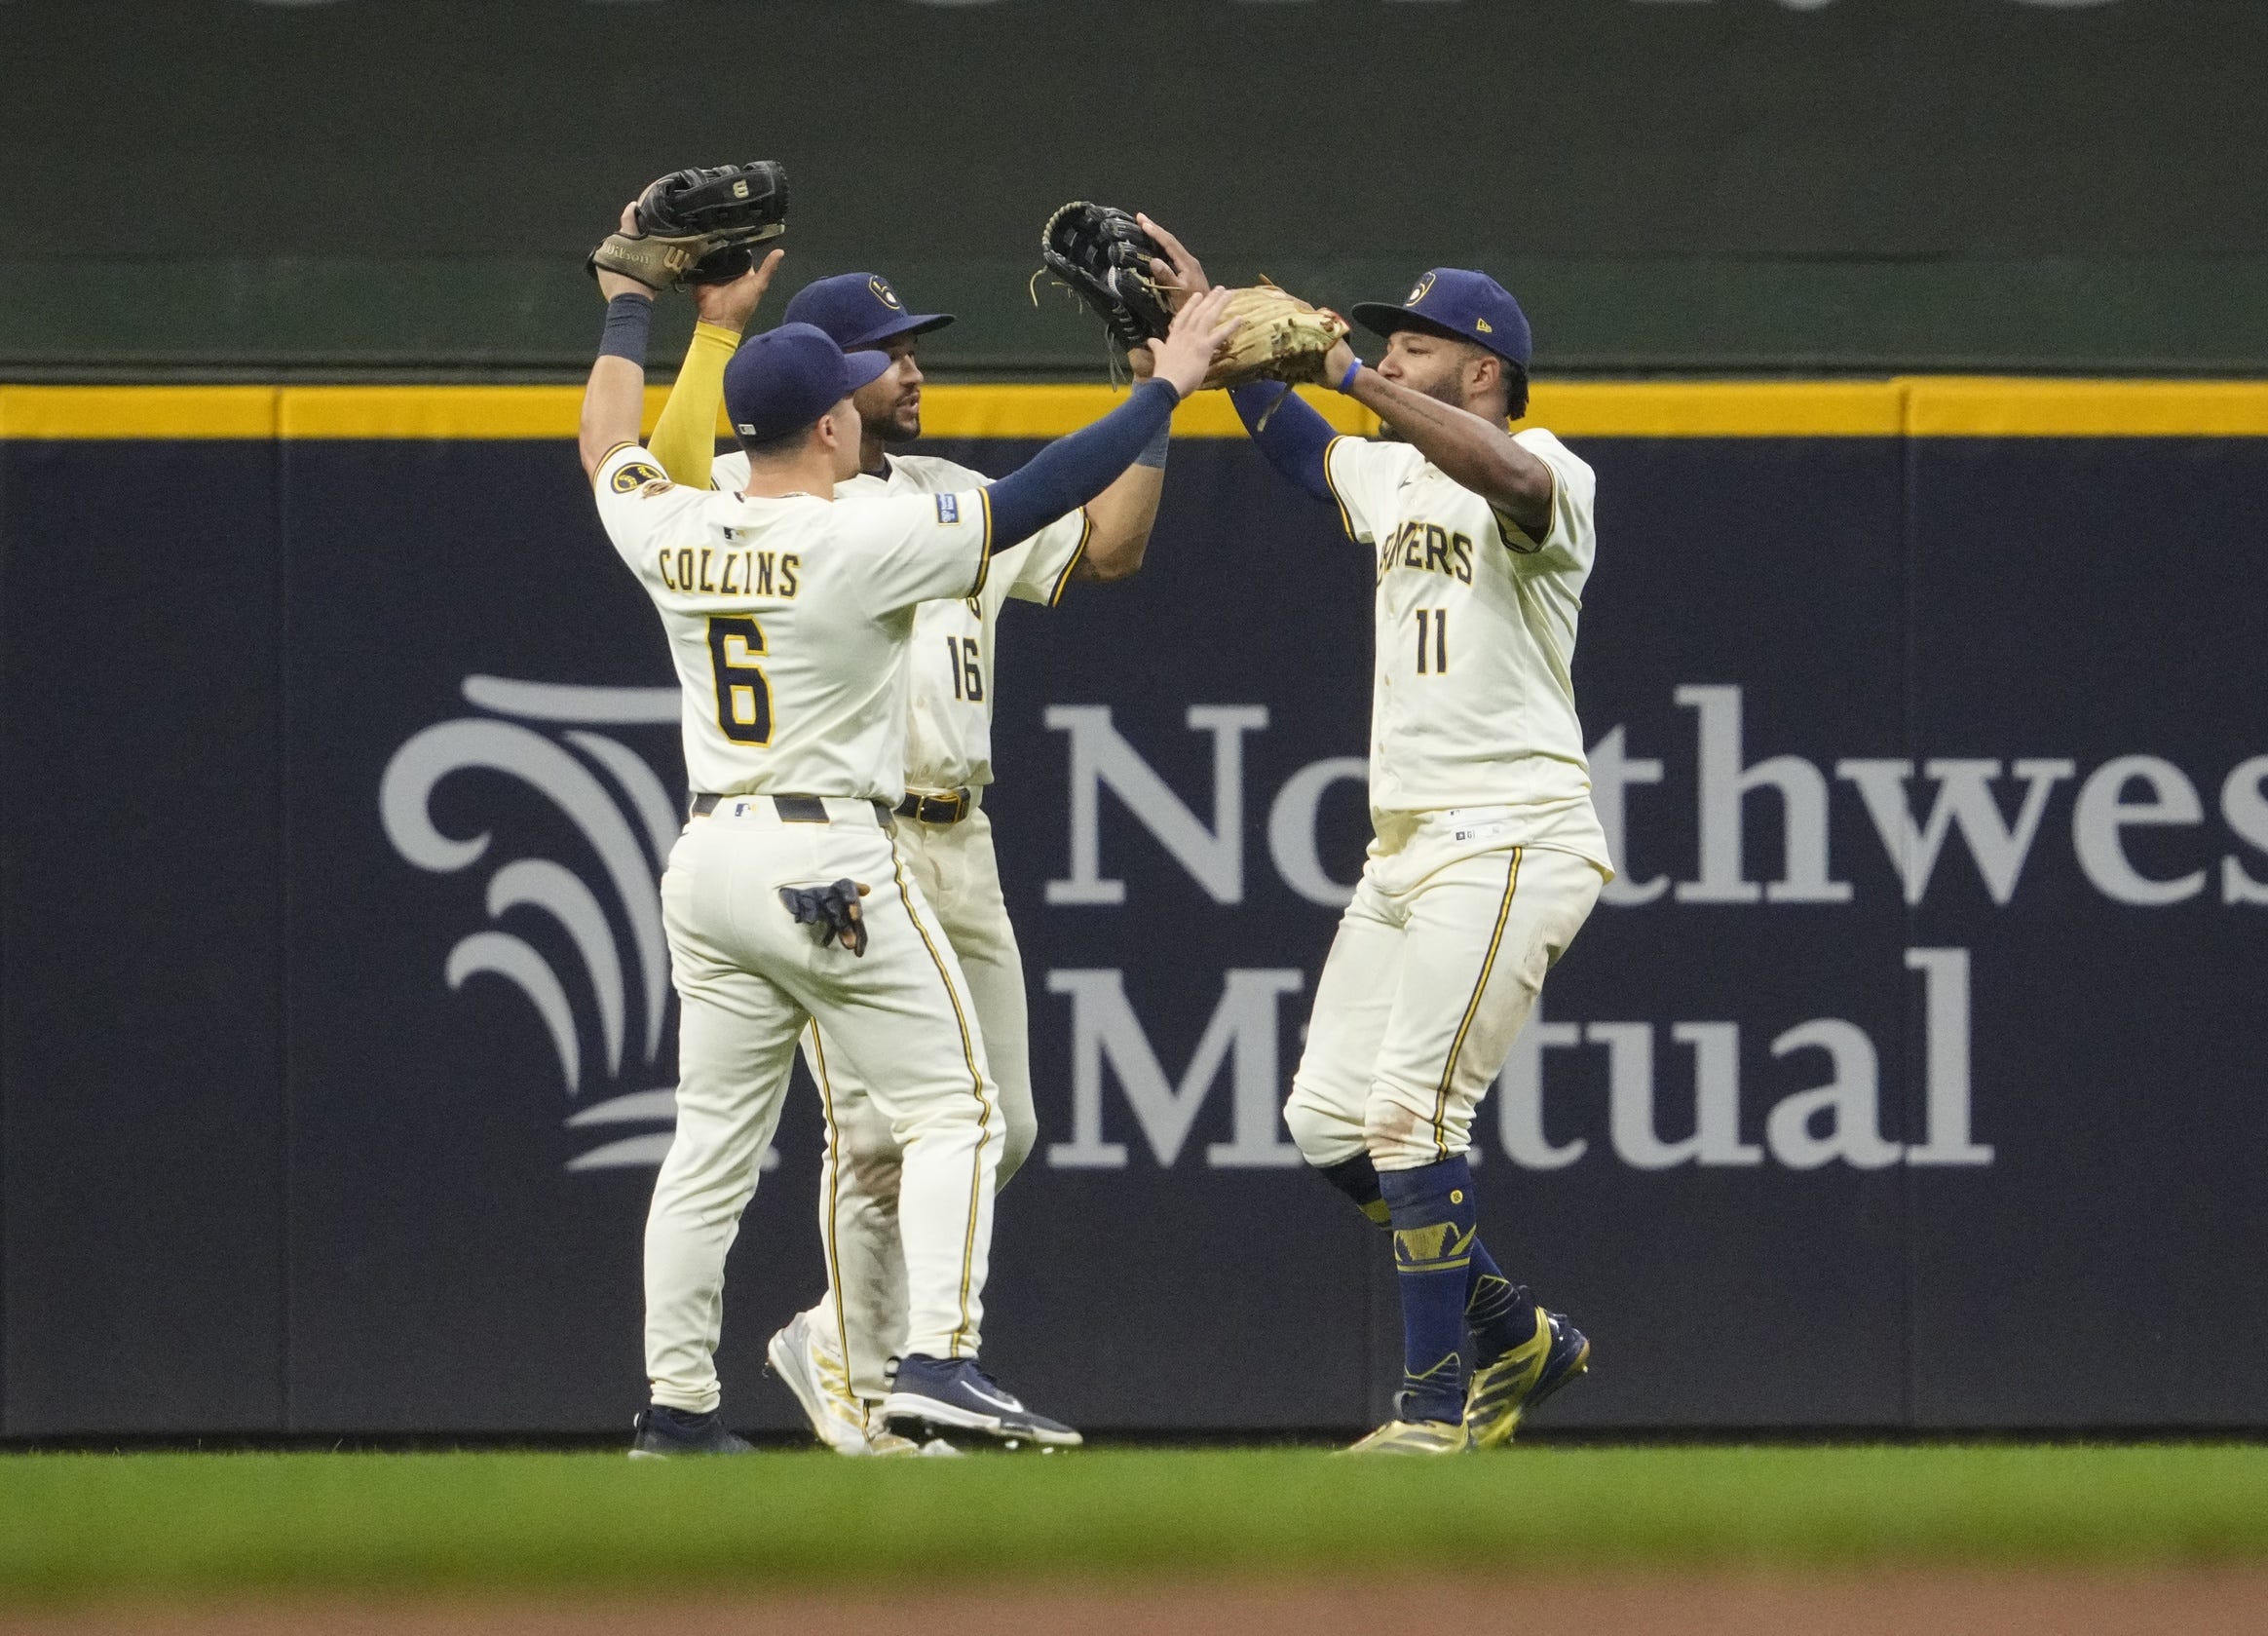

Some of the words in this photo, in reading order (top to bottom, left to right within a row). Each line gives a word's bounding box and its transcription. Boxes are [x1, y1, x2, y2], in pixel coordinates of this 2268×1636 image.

[659, 548, 802, 600] COLLINS
[705, 613, 775, 748] 6
[946, 634, 985, 704] 16
[1416, 607, 1449, 677] 11
[1044, 684, 2268, 908] Nothwes
[1045, 946, 1995, 1171] Mtual
